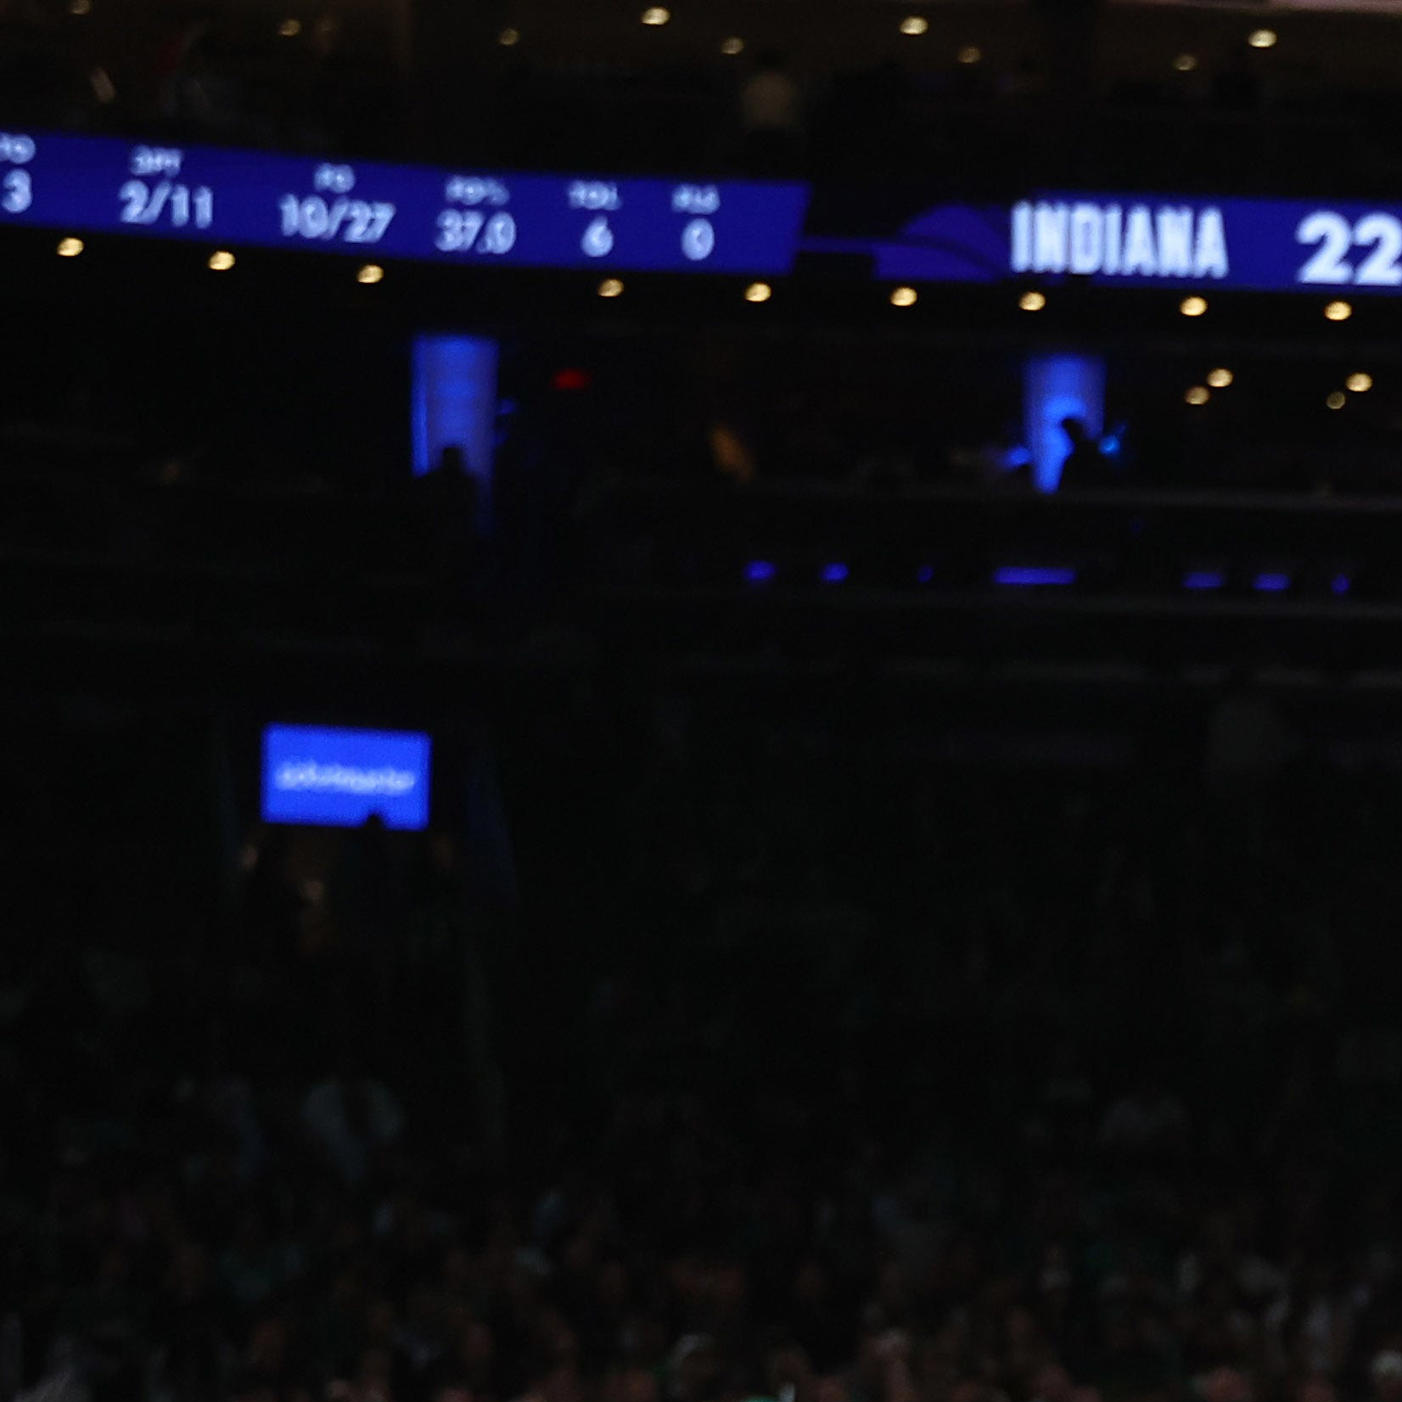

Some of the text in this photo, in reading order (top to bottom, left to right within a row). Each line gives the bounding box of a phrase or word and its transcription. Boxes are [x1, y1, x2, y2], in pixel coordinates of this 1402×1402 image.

[3, 168, 32, 214] 3
[119, 180, 213, 229] 2/11
[279, 194, 396, 243] 10/27
[582, 215, 614, 258] 6
[682, 217, 715, 261] 0
[1010, 200, 1229, 279] INDIANA
